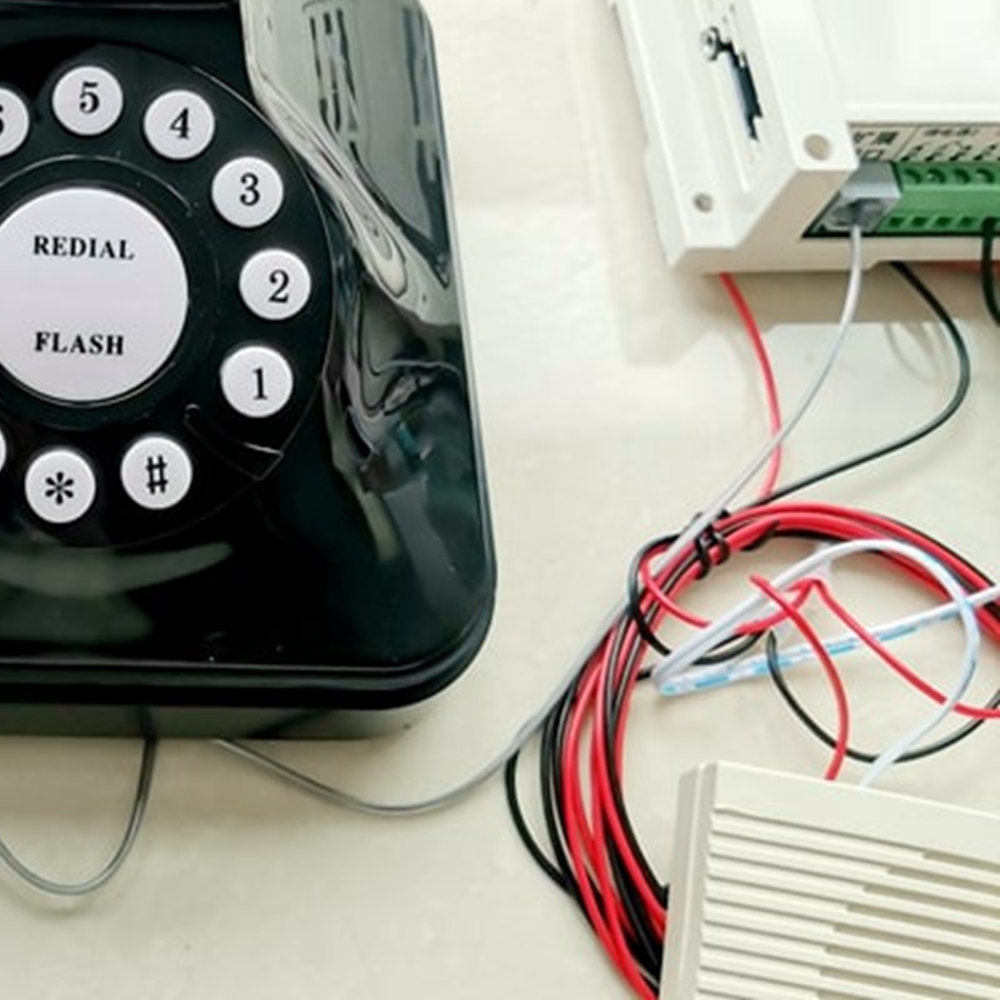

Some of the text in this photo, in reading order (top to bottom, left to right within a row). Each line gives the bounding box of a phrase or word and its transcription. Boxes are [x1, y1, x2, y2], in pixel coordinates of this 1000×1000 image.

[79, 81, 100, 114] 5
[169, 107, 190, 139] 4
[239, 172, 261, 206] 3
[32, 234, 136, 261] REDIAL
[268, 270, 290, 304] 2
[33, 330, 125, 356] FLASH
[252, 367, 270, 400] 1
[144, 454, 170, 495] #
